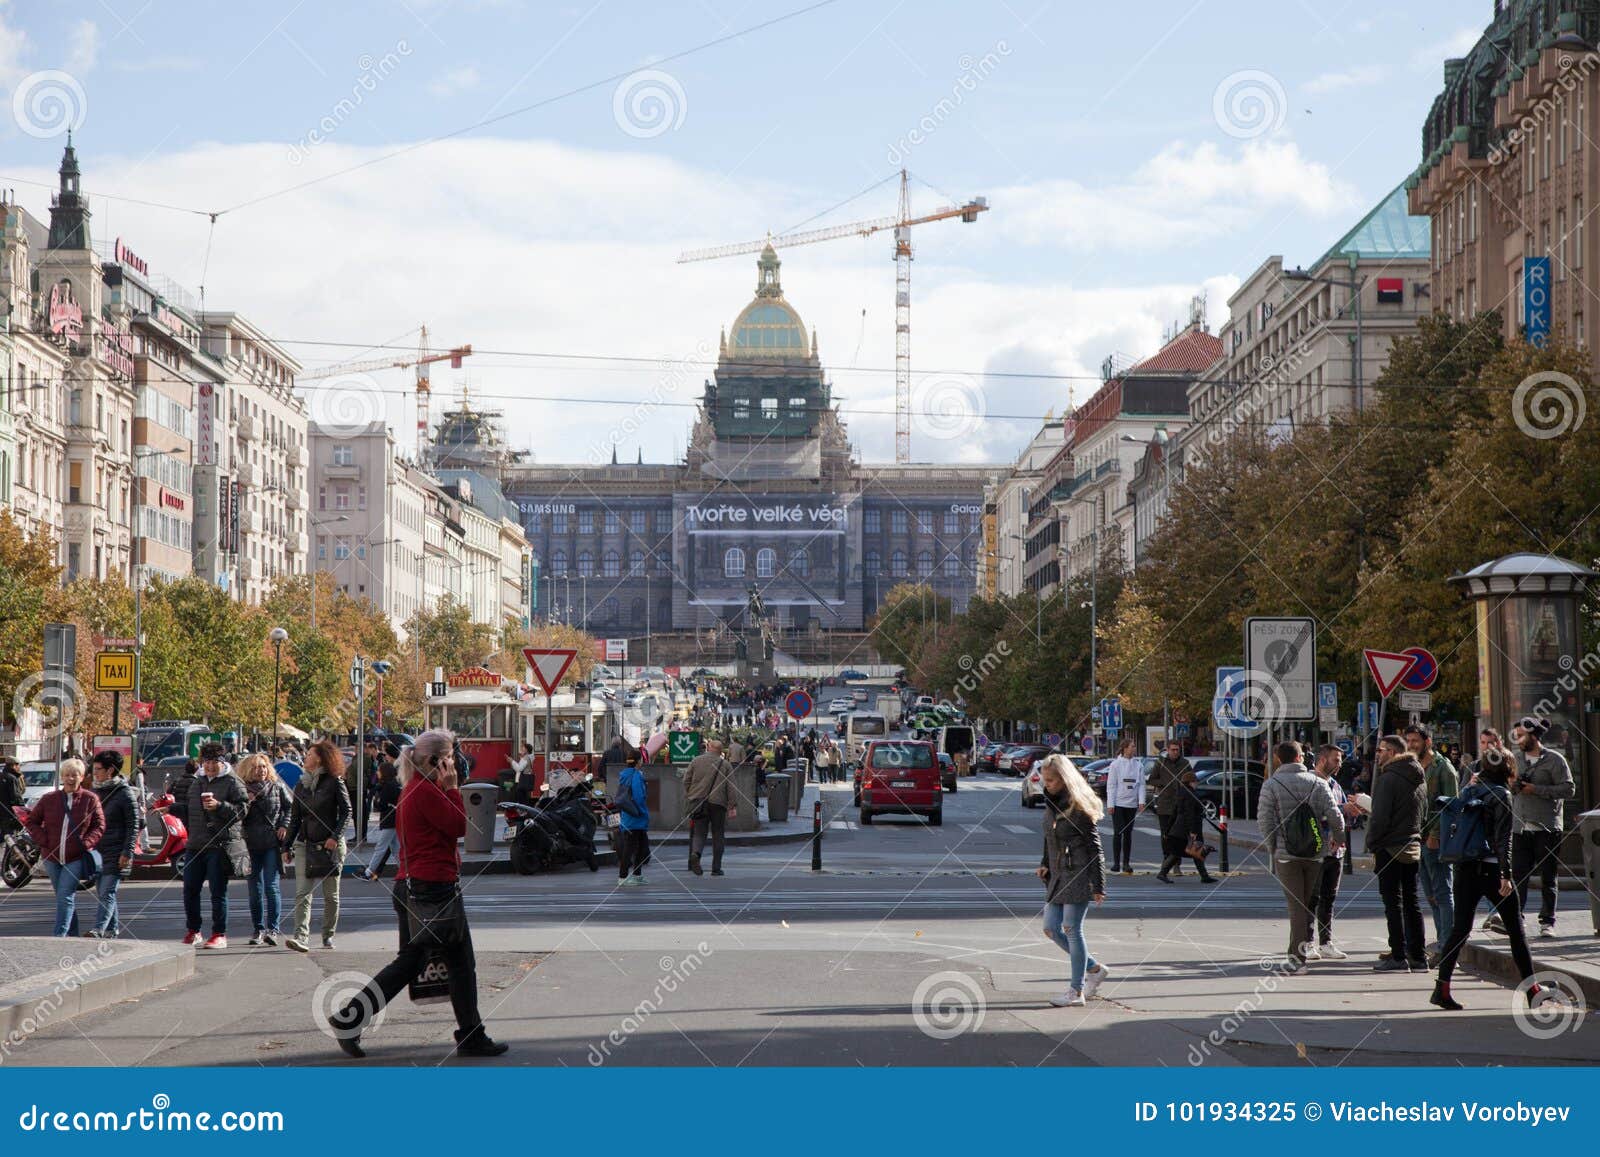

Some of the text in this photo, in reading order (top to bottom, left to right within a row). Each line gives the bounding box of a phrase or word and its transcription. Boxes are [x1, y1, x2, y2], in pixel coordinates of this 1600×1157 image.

[202, 403, 211, 463] RAMADA
[520, 503, 576, 514] SAMSUNG
[687, 504, 848, 522] Tvořte velké věci
[104, 664, 127, 679] TAXI
[450, 676, 500, 687] TRAMVAJ
[434, 684, 444, 696] 11
